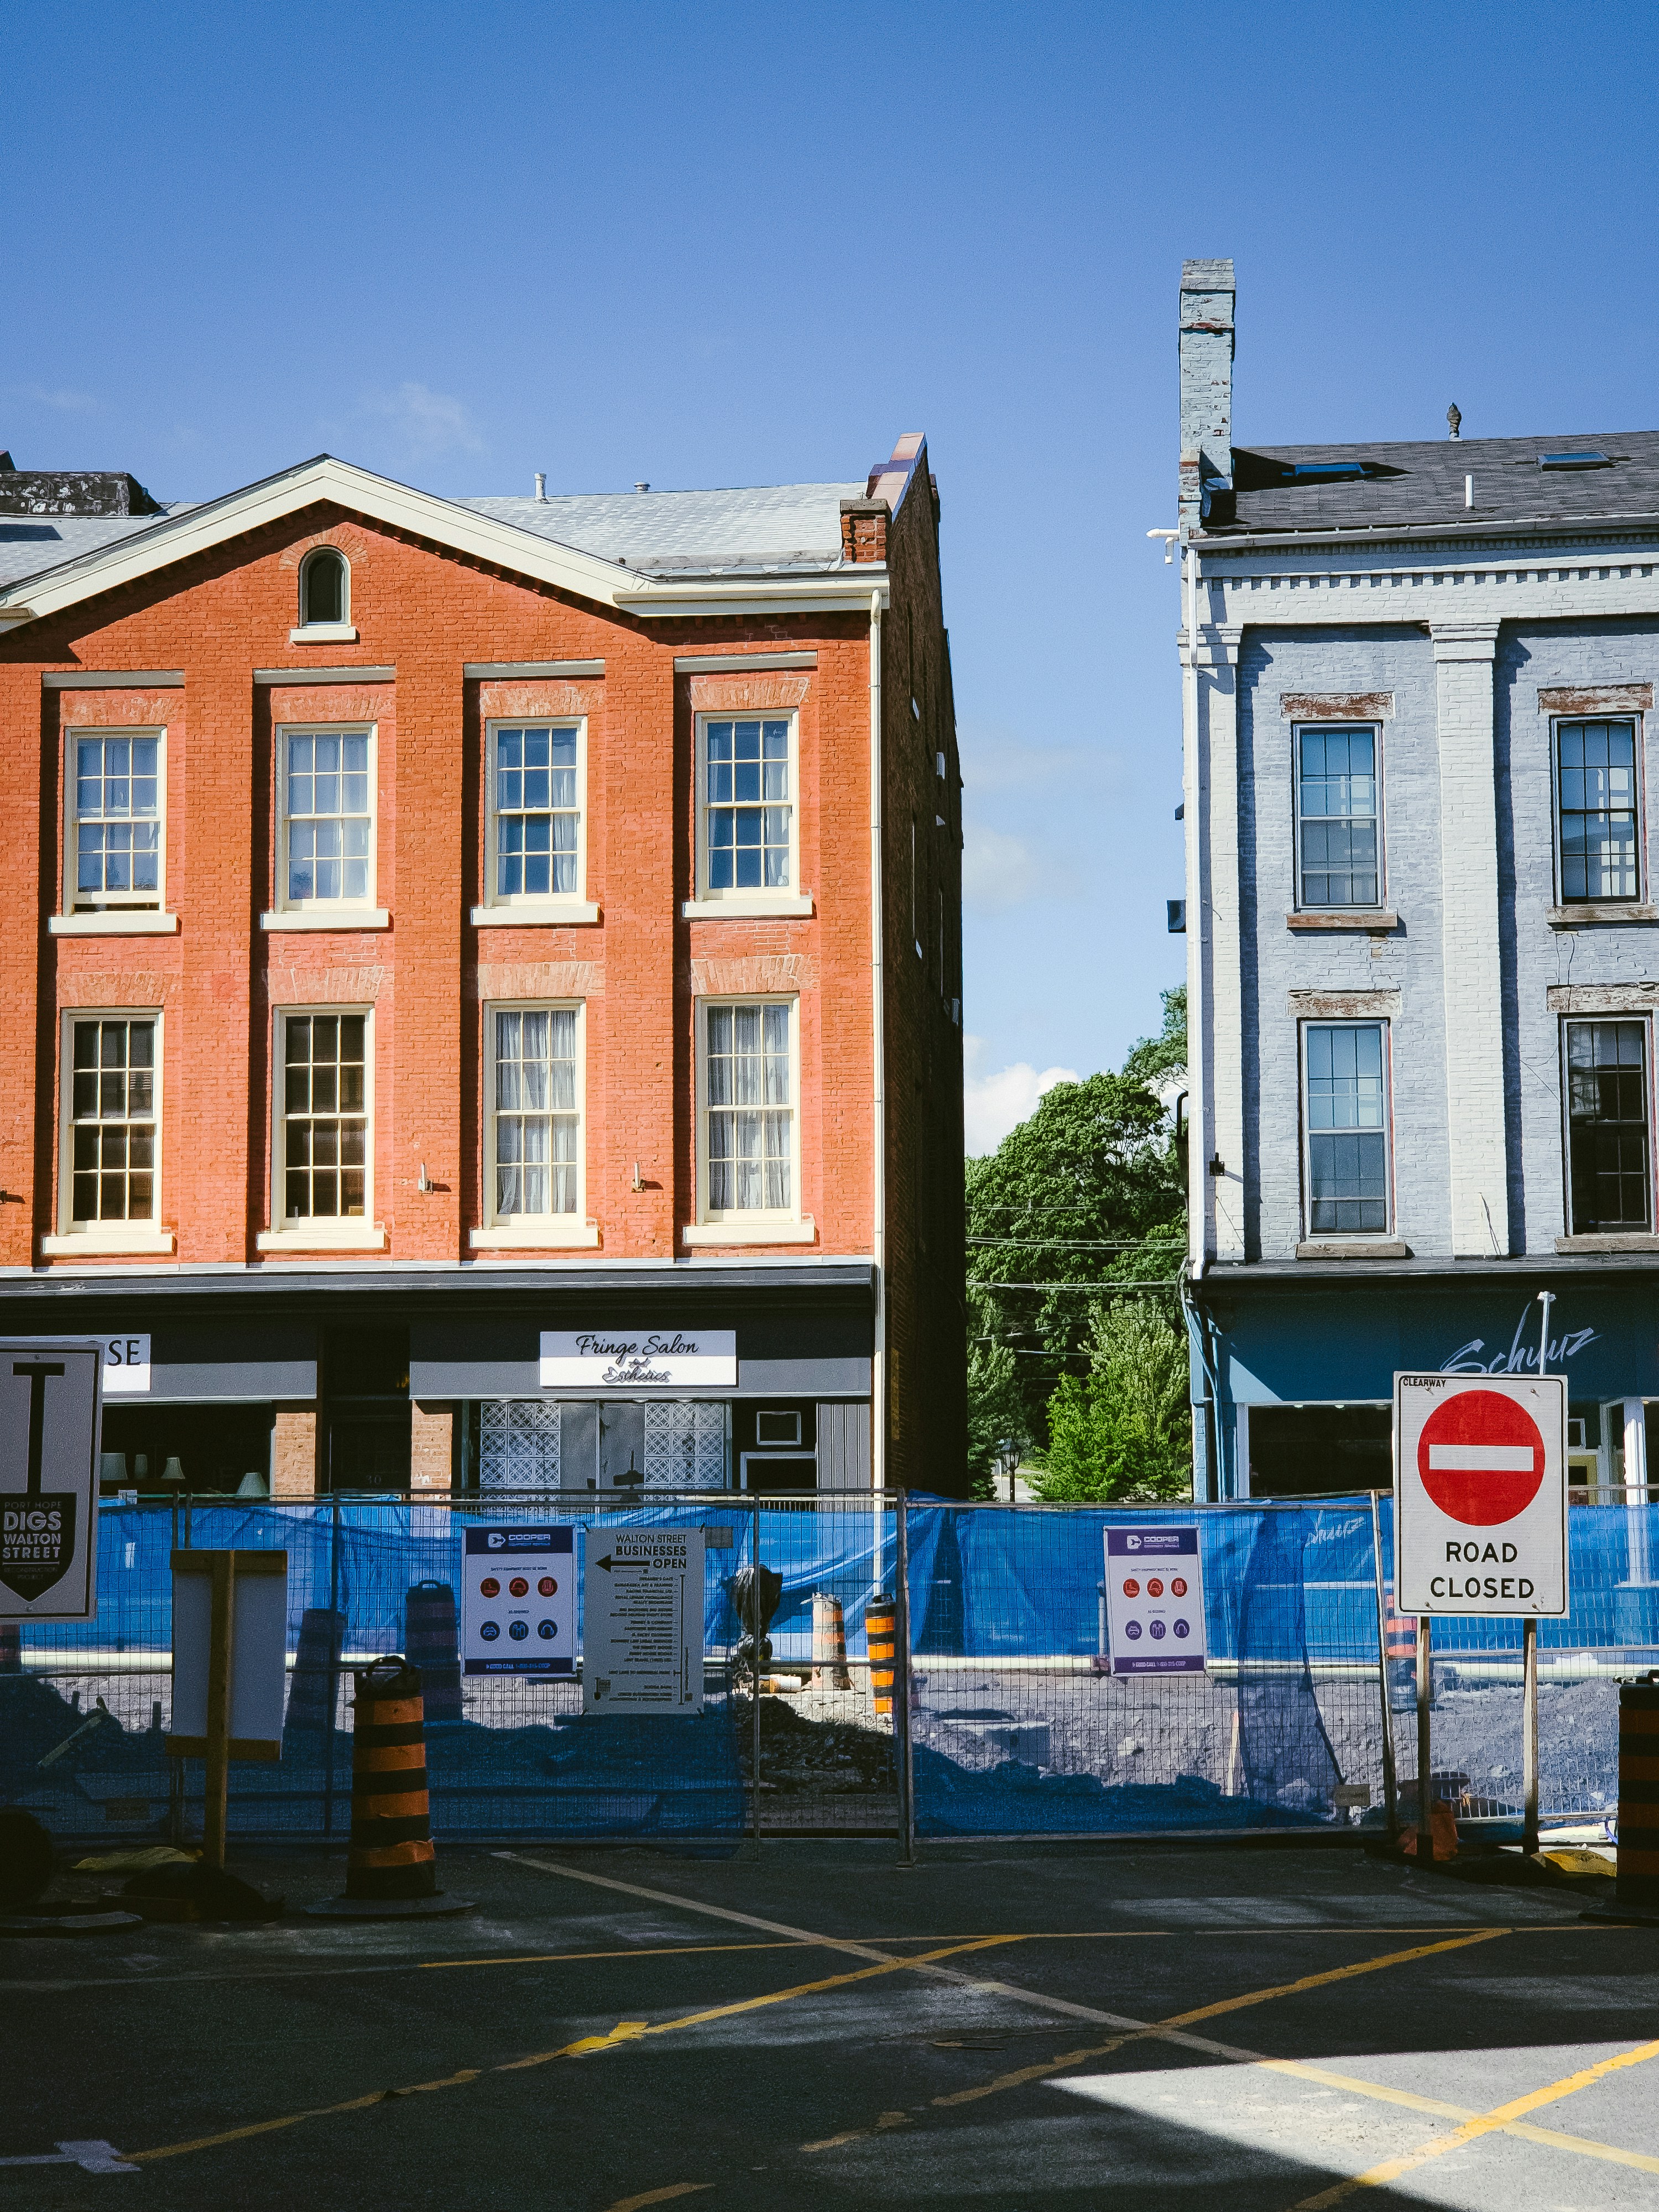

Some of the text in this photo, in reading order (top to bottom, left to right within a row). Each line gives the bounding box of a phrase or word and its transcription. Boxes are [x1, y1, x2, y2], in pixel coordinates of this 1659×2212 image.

[108, 1339, 141, 1366] SE
[576, 1334, 699, 1366] Fringe Salon
[1402, 1378, 1446, 1388] CLEARWAY
[3, 1511, 61, 1531] DIGS
[3, 1533, 61, 1545] WALTON
[615, 1534, 687, 1543] WALTON STREET
[2, 1547, 60, 1558] STREET
[615, 1546, 687, 1556] BUSINESSES
[1446, 1541, 1517, 1563] ROAD
[653, 1558, 687, 1569] OPEN
[1430, 1577, 1534, 1598] CLOSED
